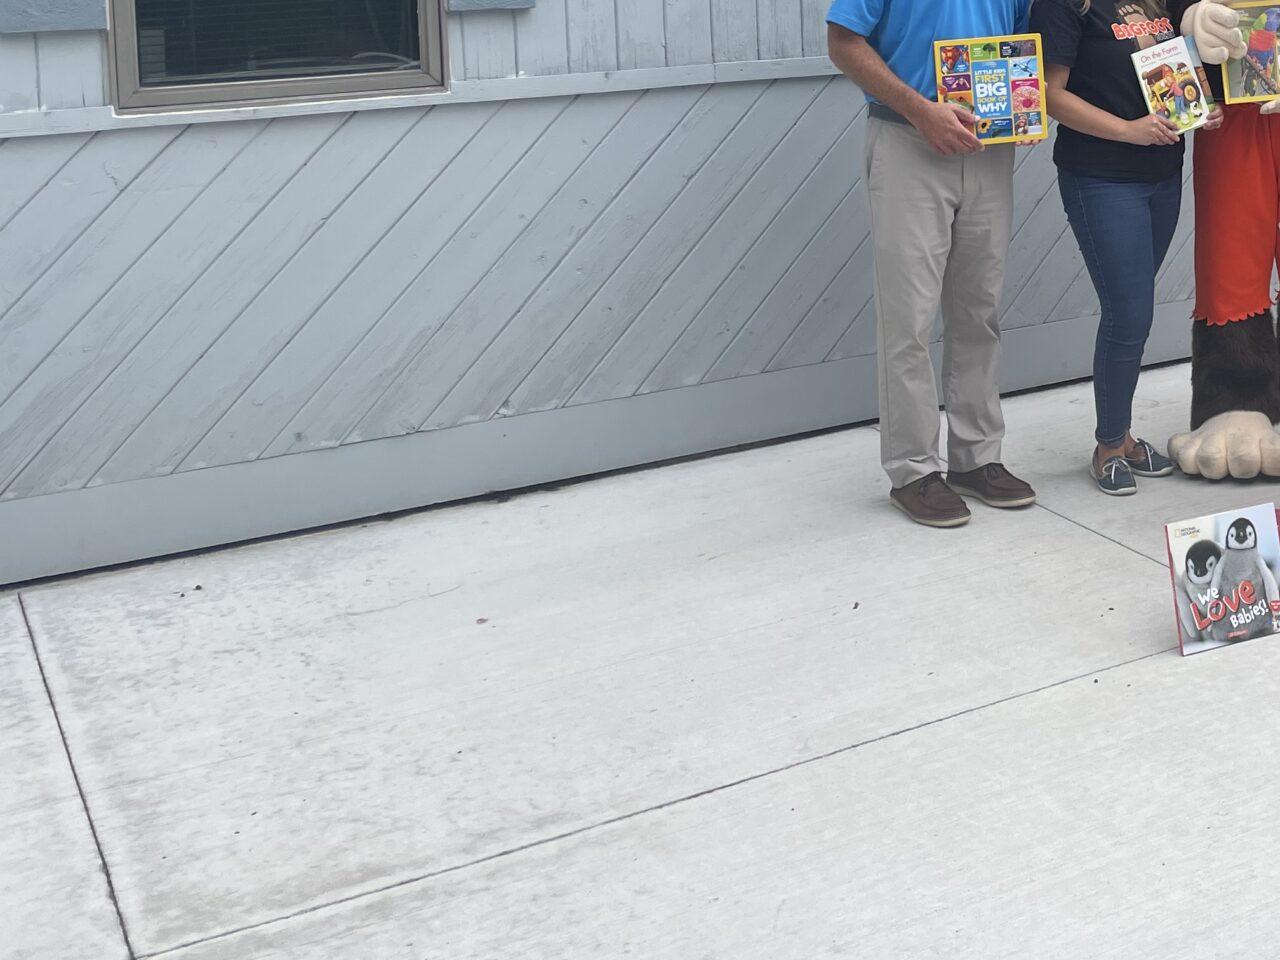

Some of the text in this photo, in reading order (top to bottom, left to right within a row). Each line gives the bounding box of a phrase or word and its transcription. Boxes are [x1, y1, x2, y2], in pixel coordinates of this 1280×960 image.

[1111, 17, 1173, 40] BIGFOOT
[975, 74, 1005, 83] FIRST
[976, 82, 1007, 98] BIG
[977, 102, 1007, 114] WHY
[1229, 599, 1270, 628] Babies!
